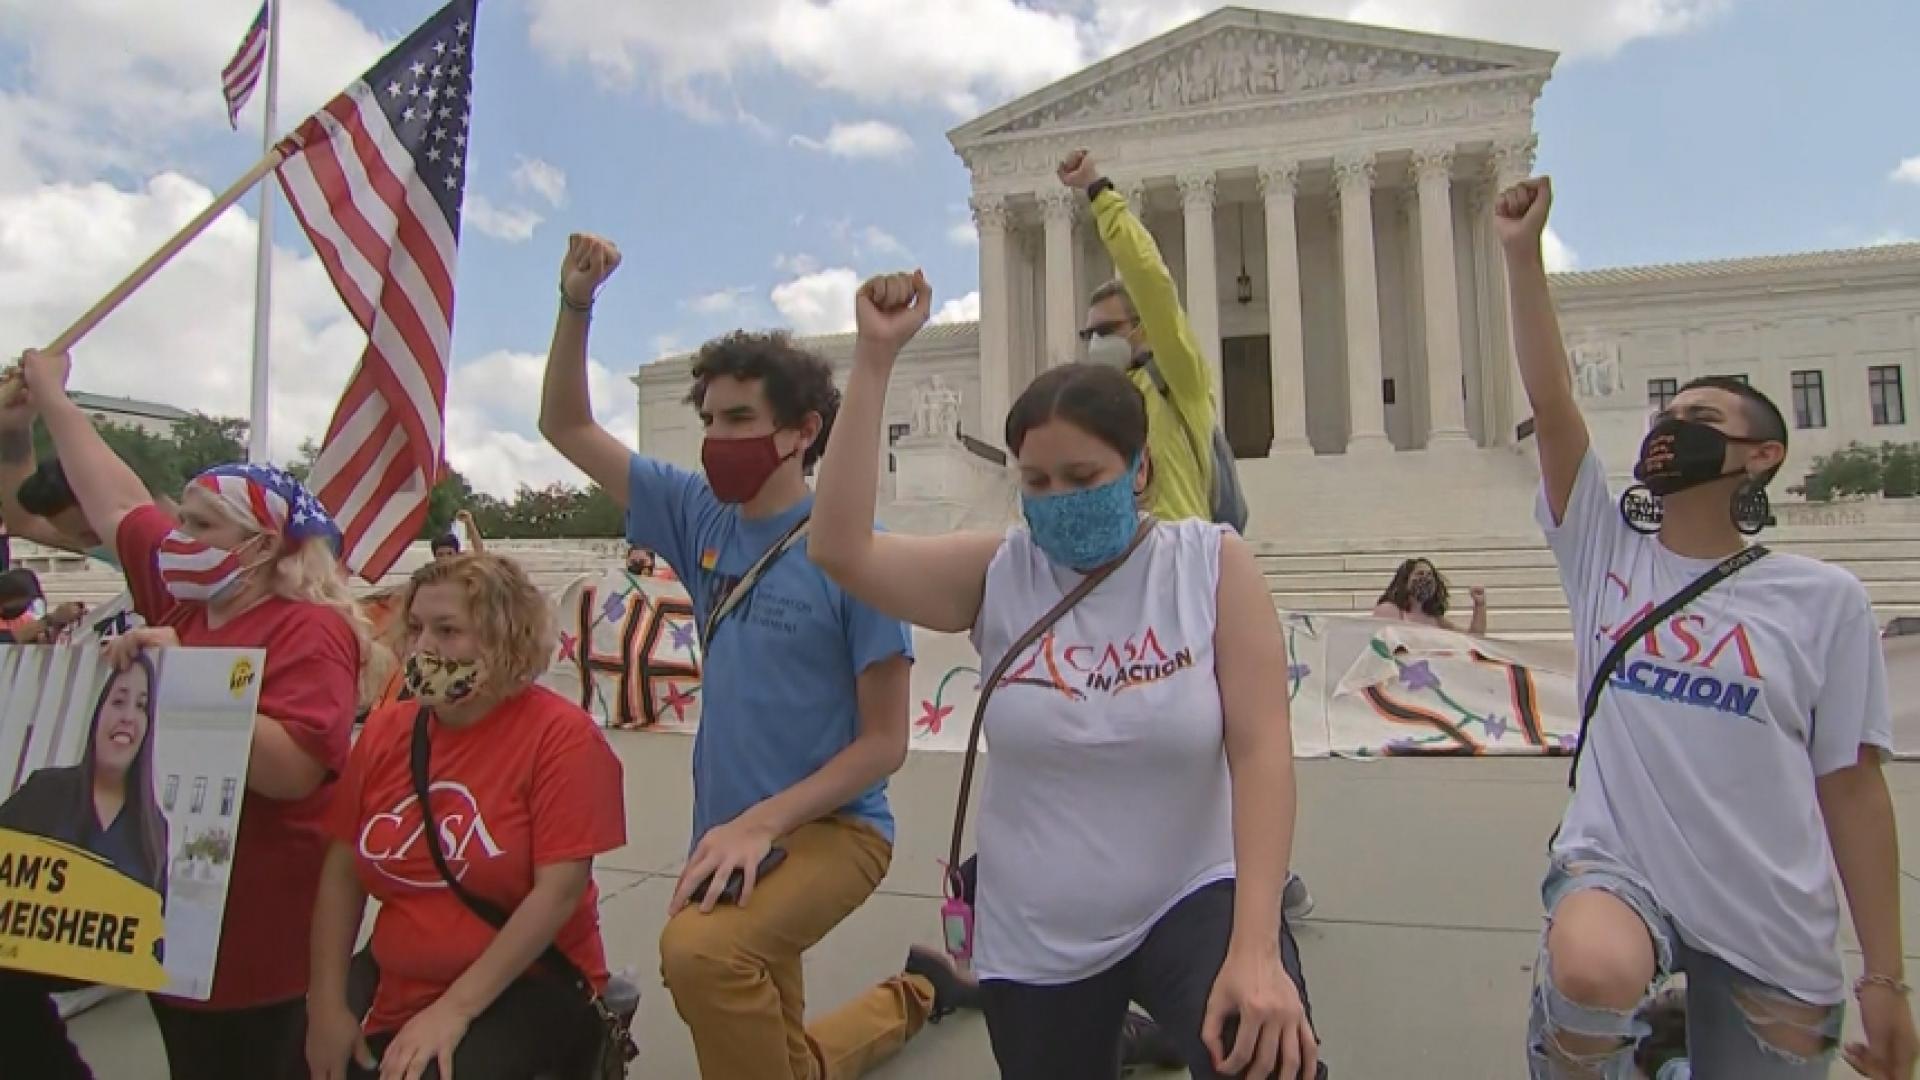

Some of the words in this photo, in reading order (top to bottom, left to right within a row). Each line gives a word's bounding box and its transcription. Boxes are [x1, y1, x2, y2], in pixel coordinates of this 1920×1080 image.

[1064, 626, 1168, 671] CASA
[1086, 673, 1112, 692] IN
[1114, 646, 1193, 683] ACTION
